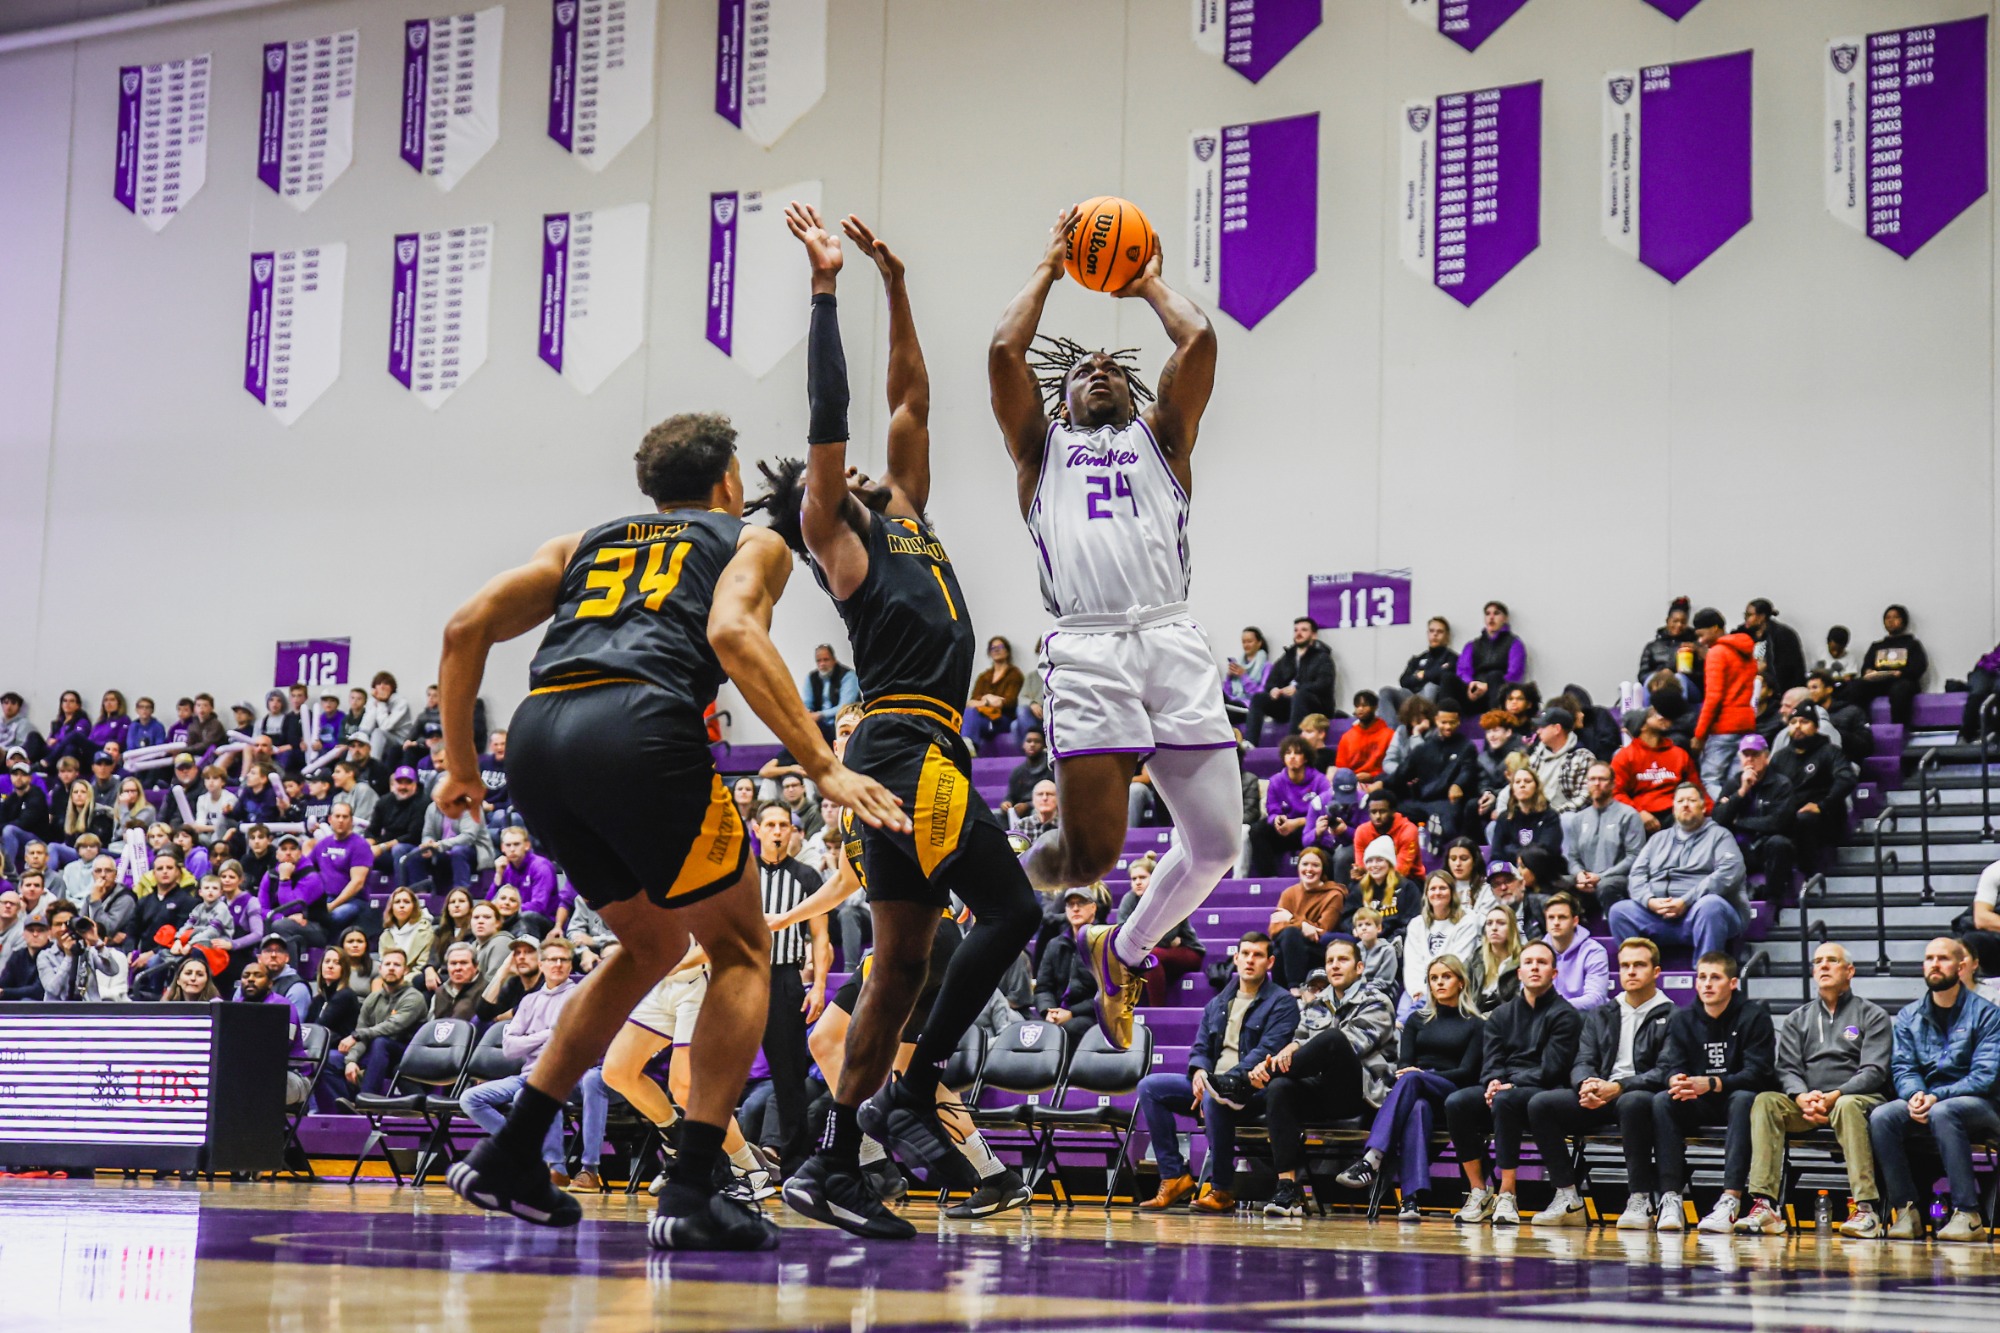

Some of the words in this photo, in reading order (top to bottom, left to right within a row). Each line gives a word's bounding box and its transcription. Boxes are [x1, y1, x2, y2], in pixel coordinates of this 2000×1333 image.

[1906, 28, 1935, 42] 2013
[1872, 47, 1901, 61] 1990
[1906, 43, 1934, 57] 2014
[1872, 62, 1899, 76] 1991
[1906, 57, 1934, 71] 2017
[1643, 78, 1671, 91] 2016
[1872, 91, 1901, 105] 1999
[1473, 103, 1499, 116] 2010
[1847, 82, 1856, 142] Champions
[1872, 105, 1902, 119] 2002
[1473, 117, 1497, 129] 2011
[1872, 119, 1902, 134] 2003
[1473, 130, 1498, 143] 2012
[1623, 112, 1631, 171] Champions
[1872, 134, 1902, 149] 2005
[1872, 149, 1902, 164] 2007
[1472, 158, 1498, 171] 2014
[1847, 146, 1856, 208] Conference
[1473, 185, 1497, 198] 2017
[1872, 179, 1902, 193] 2009
[1205, 170, 1213, 224] Champions
[1440, 189, 1467, 202] 2000
[1610, 171, 1618, 216] Women's
[1872, 193, 1902, 207] 2010
[1440, 203, 1465, 216] 2001
[1622, 174, 1631, 233] Conference
[1873, 208, 1900, 222] 2011
[1439, 216, 1466, 229] 2002
[1873, 221, 1900, 235] 2012
[1086, 214, 1114, 275] Wilson
[1439, 244, 1466, 257] 2005
[1203, 227, 1211, 283] Conference
[1438, 272, 1465, 285] 2007
[1086, 471, 1139, 520] 24
[574, 541, 692, 619] 34
[931, 564, 958, 621] 1
[1339, 587, 1394, 627] 113
[297, 652, 339, 686] 112
[930, 773, 955, 848] MILWAUKEE
[134, 1069, 200, 1104] UBS
